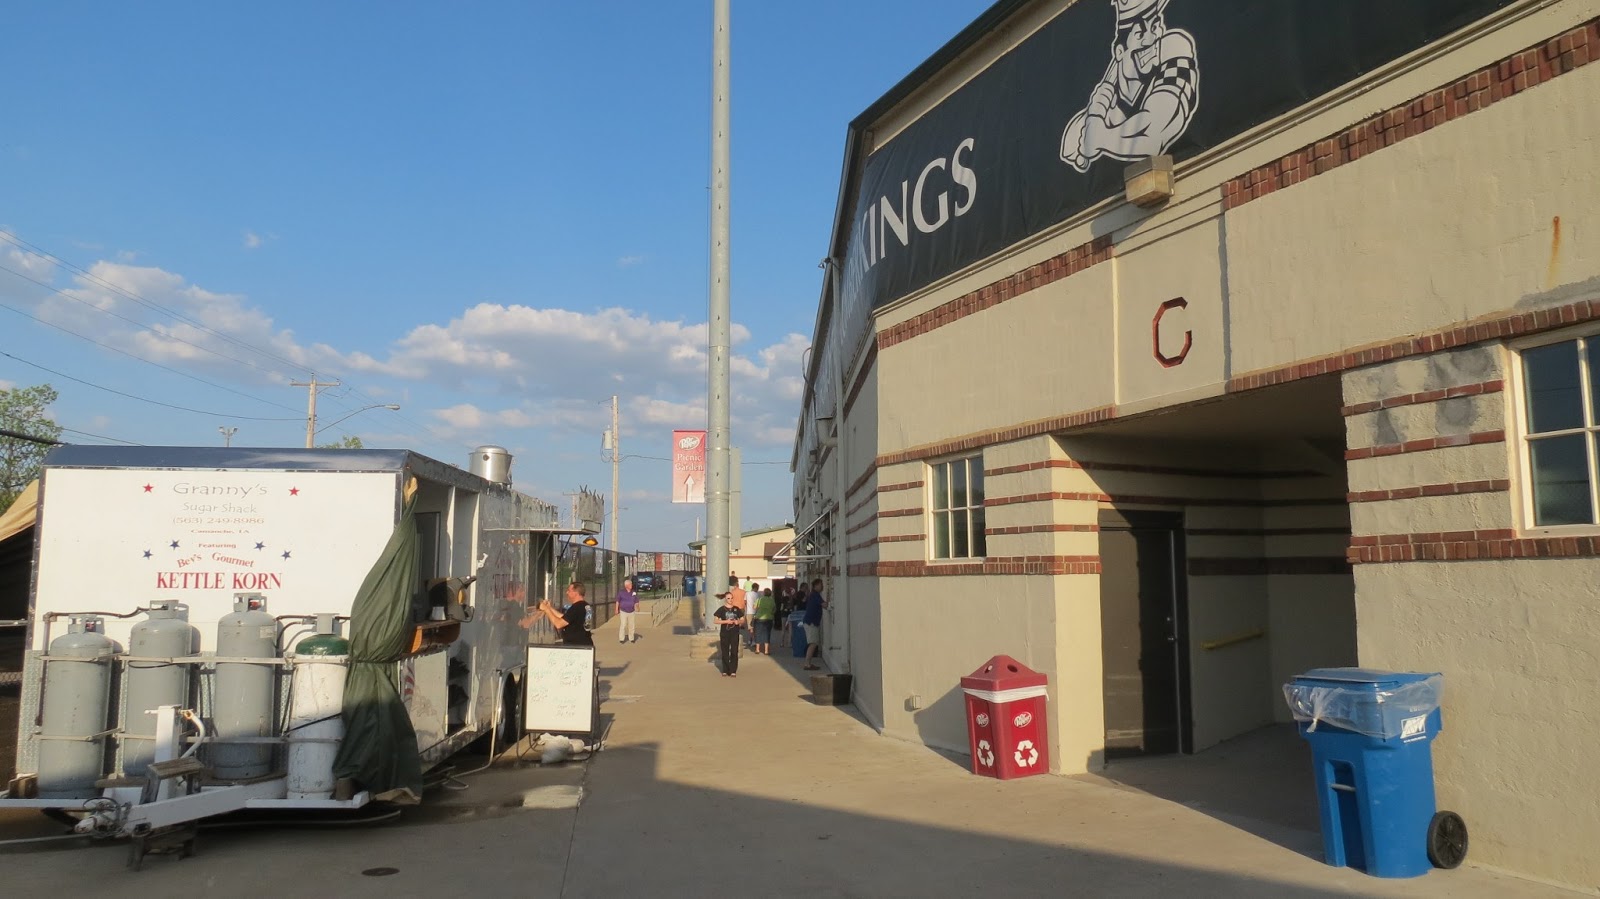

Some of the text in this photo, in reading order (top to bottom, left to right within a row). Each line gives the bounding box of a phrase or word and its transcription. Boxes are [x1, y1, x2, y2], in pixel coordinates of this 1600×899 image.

[677, 453, 702, 461] Picnic
[675, 462, 703, 471] Garden
[173, 482, 268, 499] Granny's
[183, 502, 257, 514] Sugar Shack
[177, 552, 254, 568] Bev's Gourmet
[156, 571, 282, 590] KETTLE KORN
